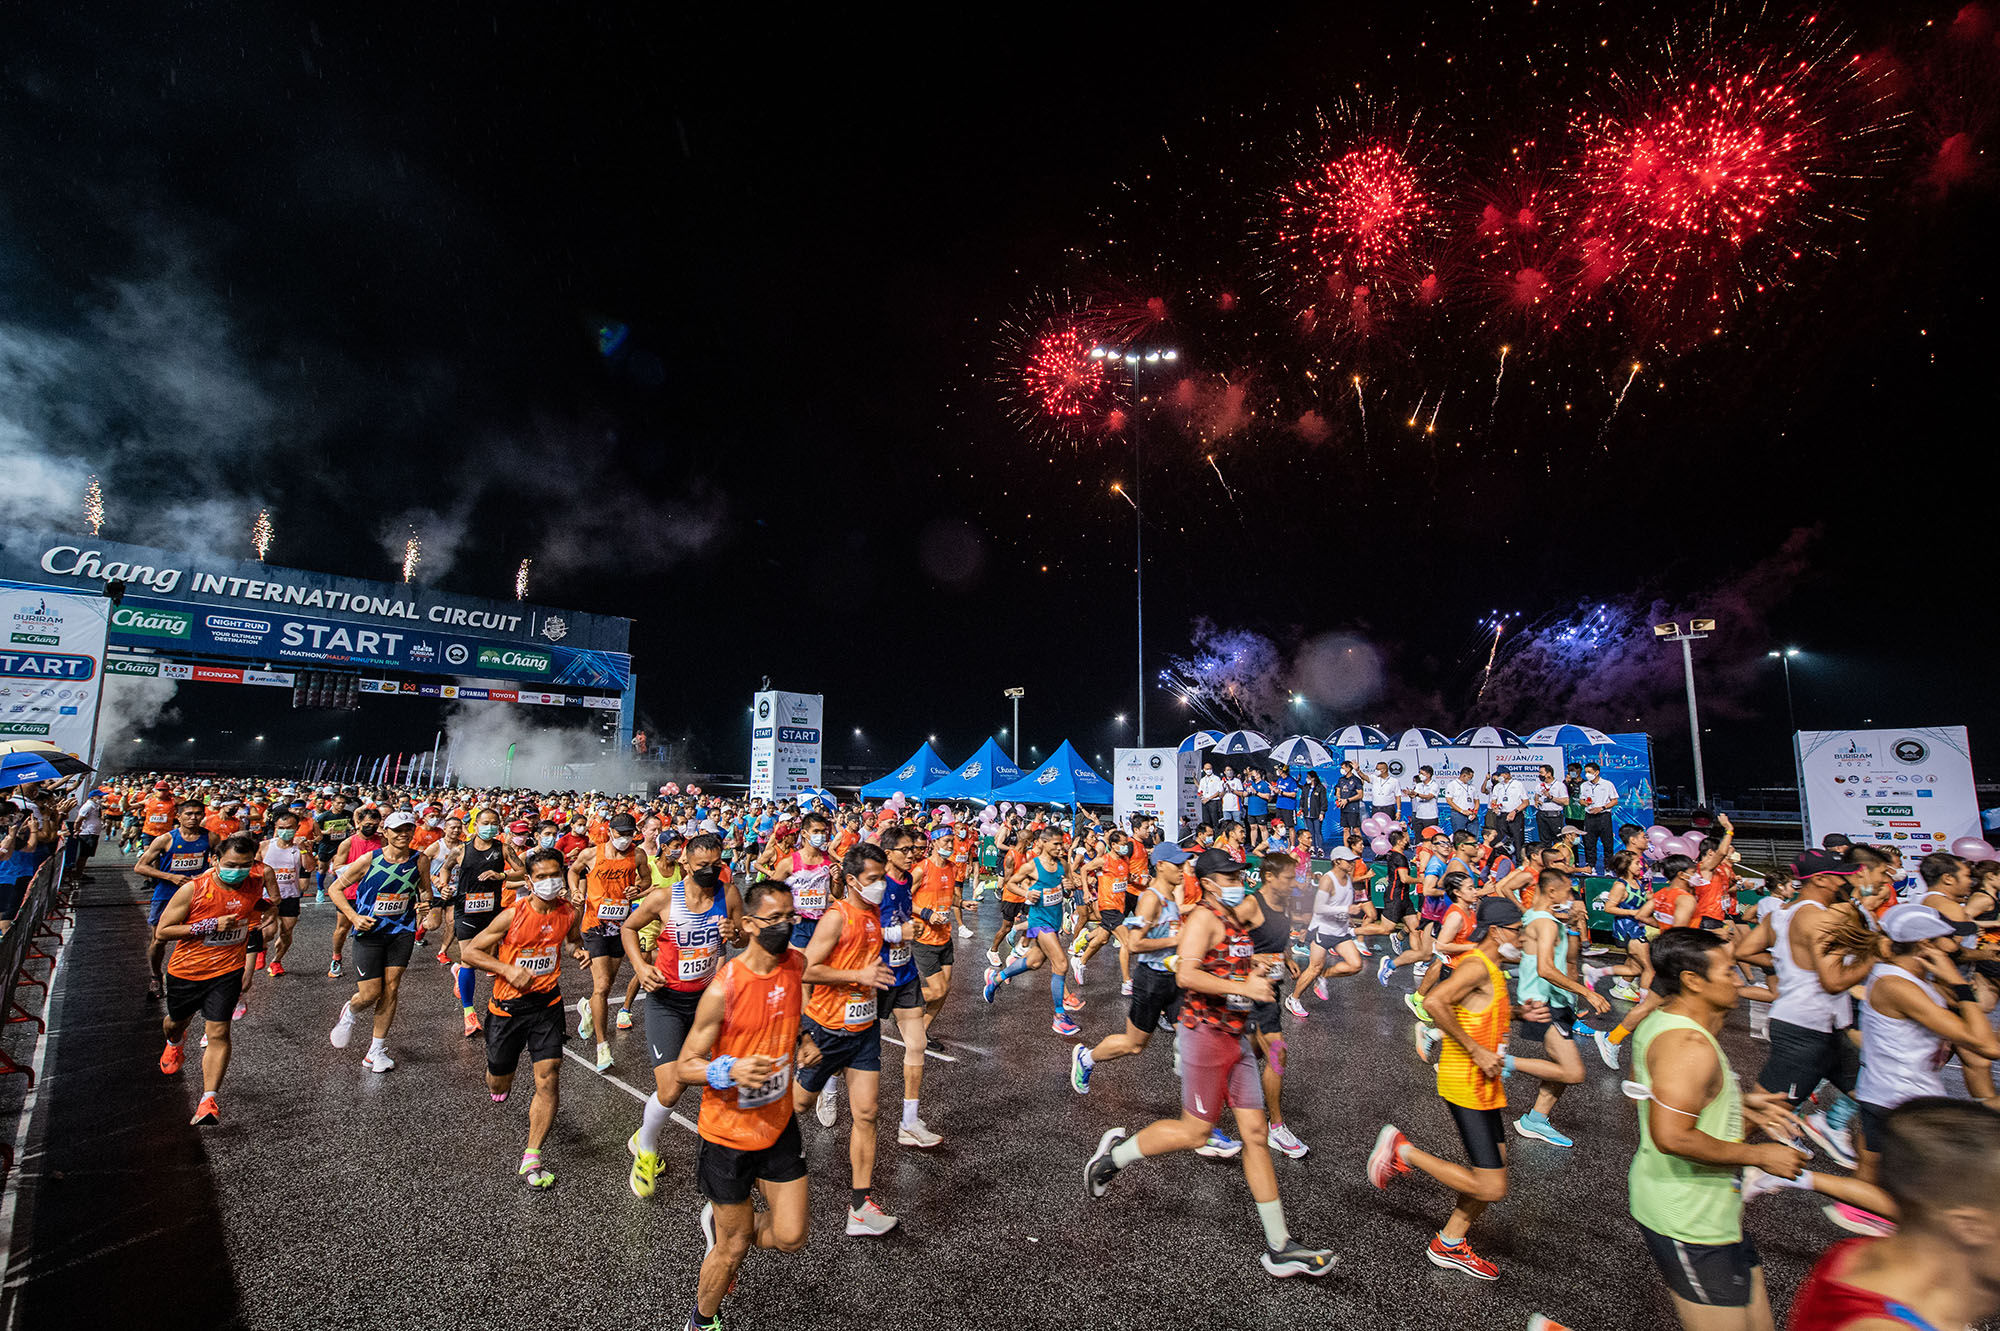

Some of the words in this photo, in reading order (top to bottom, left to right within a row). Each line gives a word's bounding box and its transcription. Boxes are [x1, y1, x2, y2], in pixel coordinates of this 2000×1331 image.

[40, 545, 183, 594] Chang
[191, 572, 421, 621] INTERNATIONAL
[428, 605, 522, 632] CIRCUIT
[13, 613, 64, 624] BURIRAM
[111, 608, 188, 635] Chang
[212, 618, 243, 628] NIGHT
[244, 622, 265, 630] RUN
[26, 635, 58, 645] Chang
[211, 630, 231, 638] YOUR
[231, 632, 263, 641] ULTIMATE
[214, 636, 259, 645] DESTINATION
[280, 621, 404, 656] START
[501, 651, 549, 671] Chang
[115, 661, 157, 676] Chang
[197, 670, 240, 680] HONDA
[466, 690, 488, 698] YAMAHA
[11, 723, 48, 734] Chang
[755, 729, 772, 738] START
[782, 730, 816, 741] START
[995, 765, 1019, 775] Chang
[1074, 768, 1097, 779] Chang
[1881, 806, 1911, 815] Chang
[174, 859, 199, 868] 21303
[377, 901, 402, 911] 21664
[468, 900, 489, 909] 21351
[676, 927, 720, 947] USA
[519, 957, 551, 970] 20198
